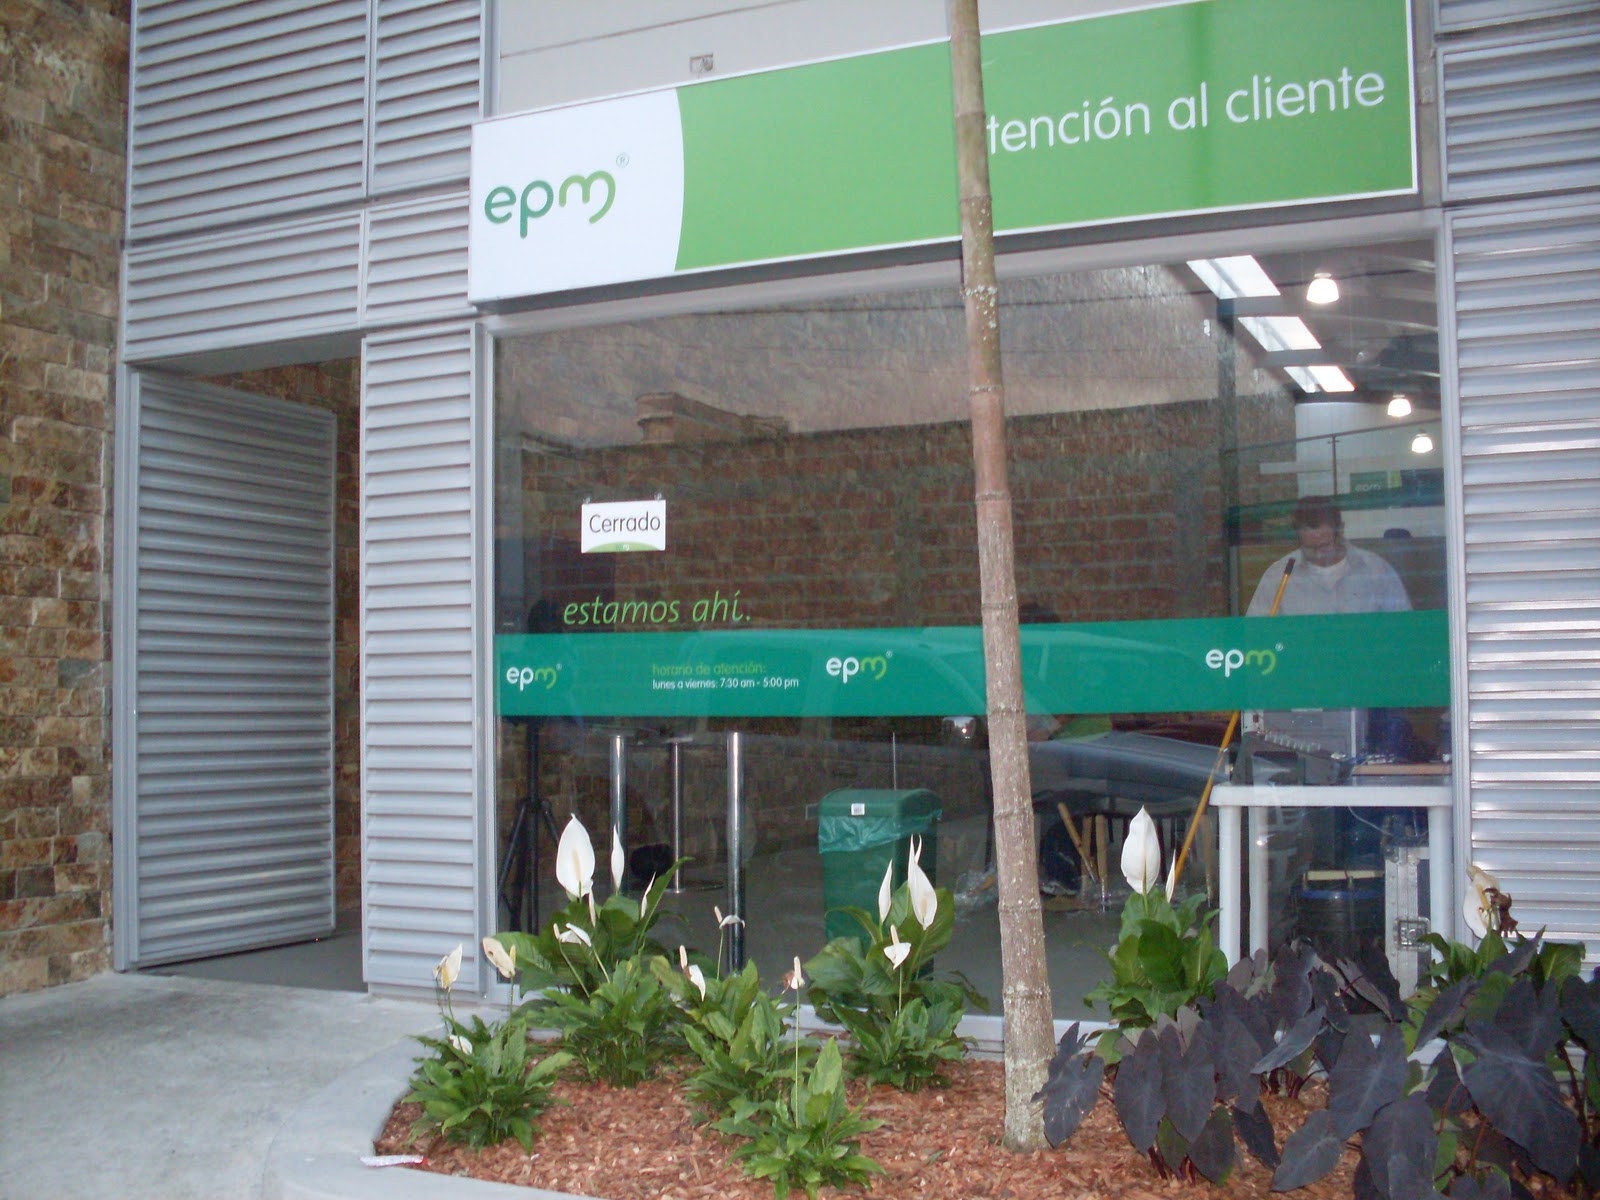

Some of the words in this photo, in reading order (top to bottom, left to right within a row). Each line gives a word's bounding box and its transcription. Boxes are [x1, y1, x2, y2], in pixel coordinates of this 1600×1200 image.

[985, 97, 1151, 155] tención
[1167, 82, 1208, 131] al
[1225, 66, 1386, 124] cliente
[589, 510, 661, 533] Cerrado
[563, 595, 680, 625] estamos
[692, 589, 751, 623] ahí.
[652, 663, 692, 676] horario
[695, 662, 711, 675] de
[713, 661, 767, 675] atención:
[652, 679, 676, 690] lunes
[677, 680, 684, 690] a
[685, 678, 718, 690] viernes:
[720, 677, 739, 689] 7:30
[740, 679, 755, 689] am
[763, 676, 783, 688] 5:00
[784, 678, 799, 690] pm
